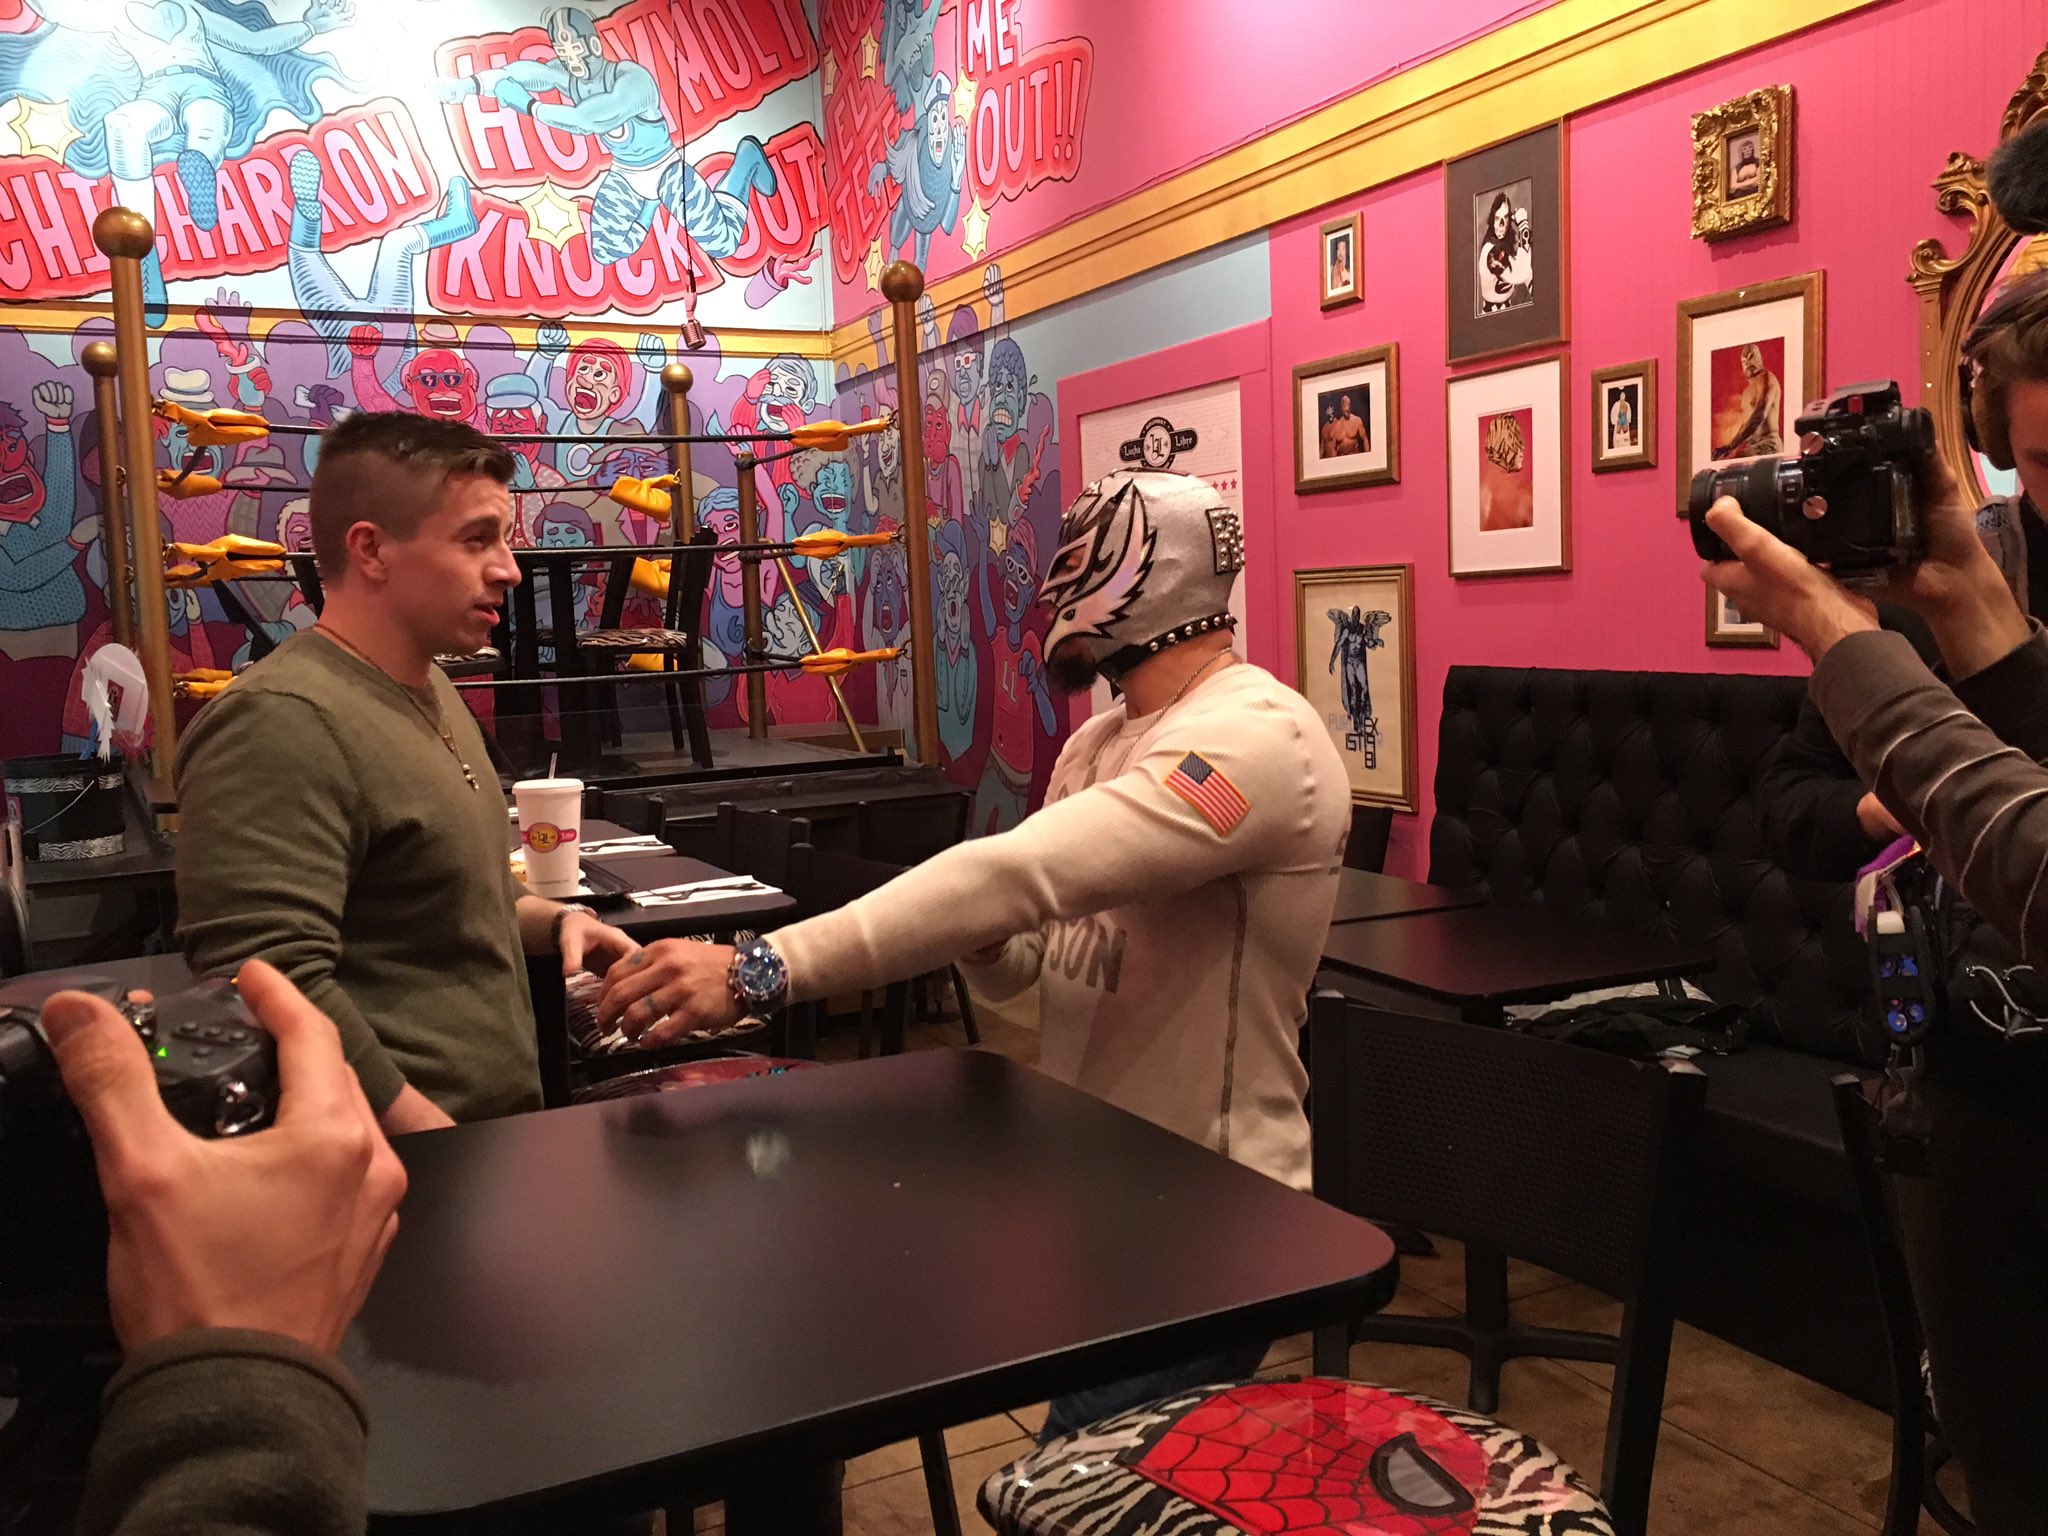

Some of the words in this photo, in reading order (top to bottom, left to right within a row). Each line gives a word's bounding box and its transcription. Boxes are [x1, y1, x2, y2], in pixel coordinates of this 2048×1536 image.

[455, 16, 679, 171] HOY
[967, 0, 1014, 74] ME
[976, 58, 1083, 187] OUT!!
[0, 111, 428, 291] CHIHARON
